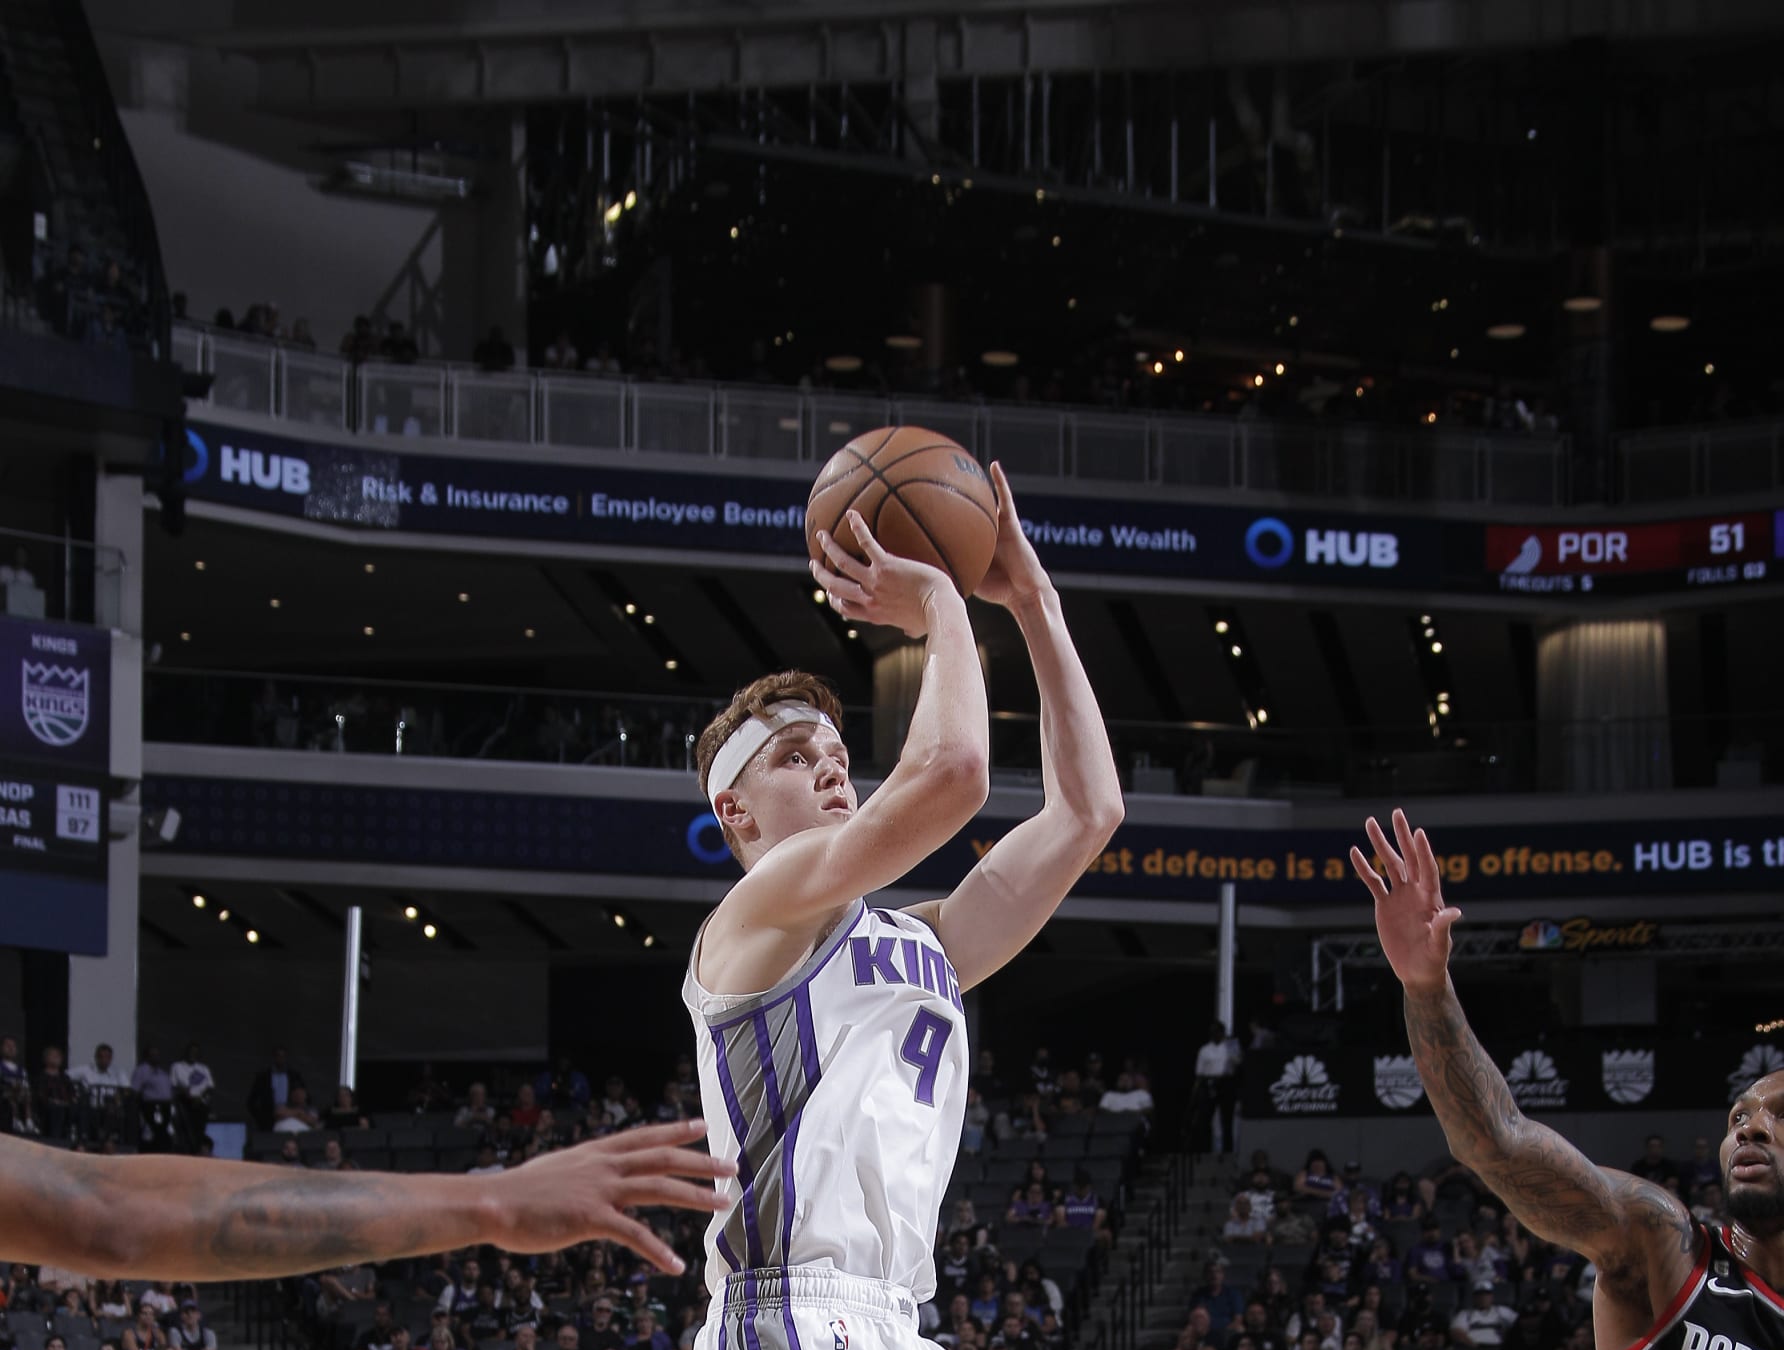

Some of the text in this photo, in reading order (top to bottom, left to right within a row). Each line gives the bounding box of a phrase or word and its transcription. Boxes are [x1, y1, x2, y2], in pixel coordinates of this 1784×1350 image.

[220, 446, 310, 494] HUB
[361, 475, 569, 515] Risk & Insurance
[591, 493, 807, 529] Employee Benefi
[1110, 525, 1197, 551] Wealth
[1304, 528, 1399, 568] HUB
[1557, 532, 1628, 563] POR
[1709, 522, 1745, 555] 51
[31, 633, 78, 656] KINGS
[68, 792, 91, 810] 111
[1142, 849, 1276, 881] defense
[1286, 852, 1315, 880] is
[1323, 861, 1344, 880] a
[1479, 846, 1623, 877] offense.
[1634, 840, 1713, 871] HUB
[1723, 839, 1752, 869] is
[1561, 914, 1660, 951] Sports
[849, 936, 965, 1016] KING
[900, 1005, 954, 1109] 9
